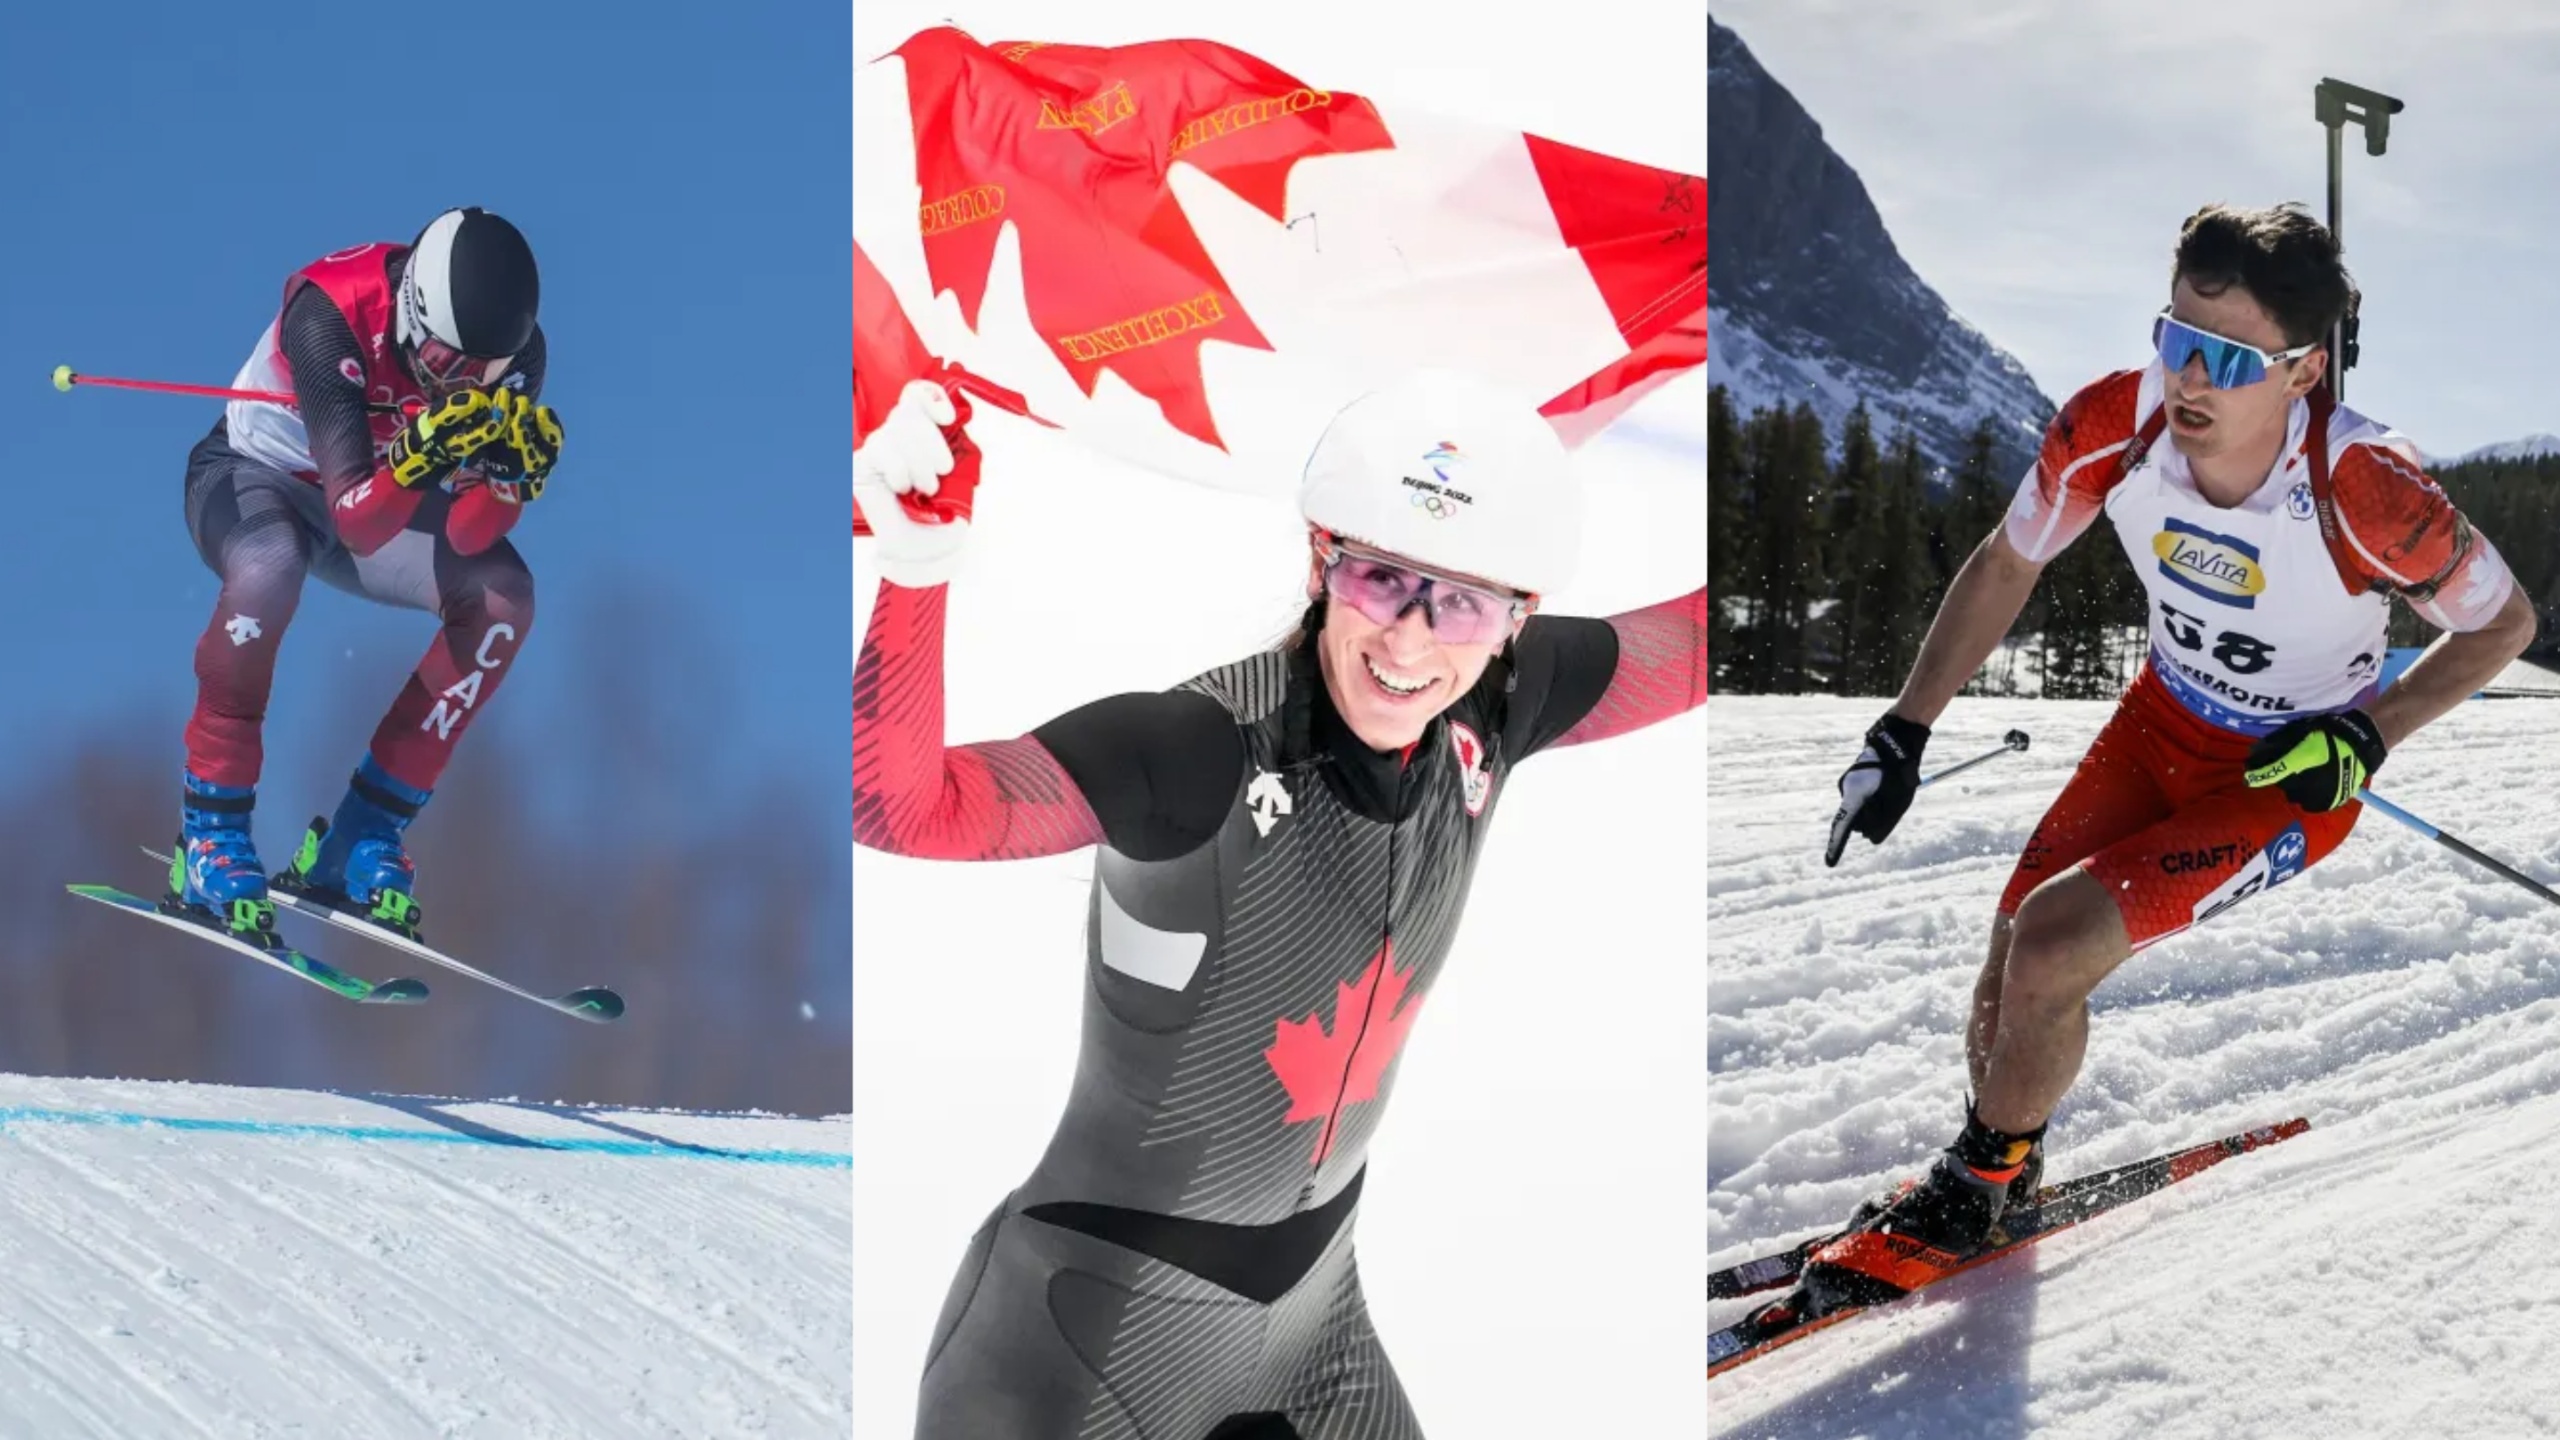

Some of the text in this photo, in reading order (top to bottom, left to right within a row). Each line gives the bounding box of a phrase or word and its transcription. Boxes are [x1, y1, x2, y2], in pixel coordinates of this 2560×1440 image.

[1058, 290, 1226, 362] EXCELLENCE
[421, 622, 515, 741] CAN
[2159, 844, 2238, 875] CRAFT
